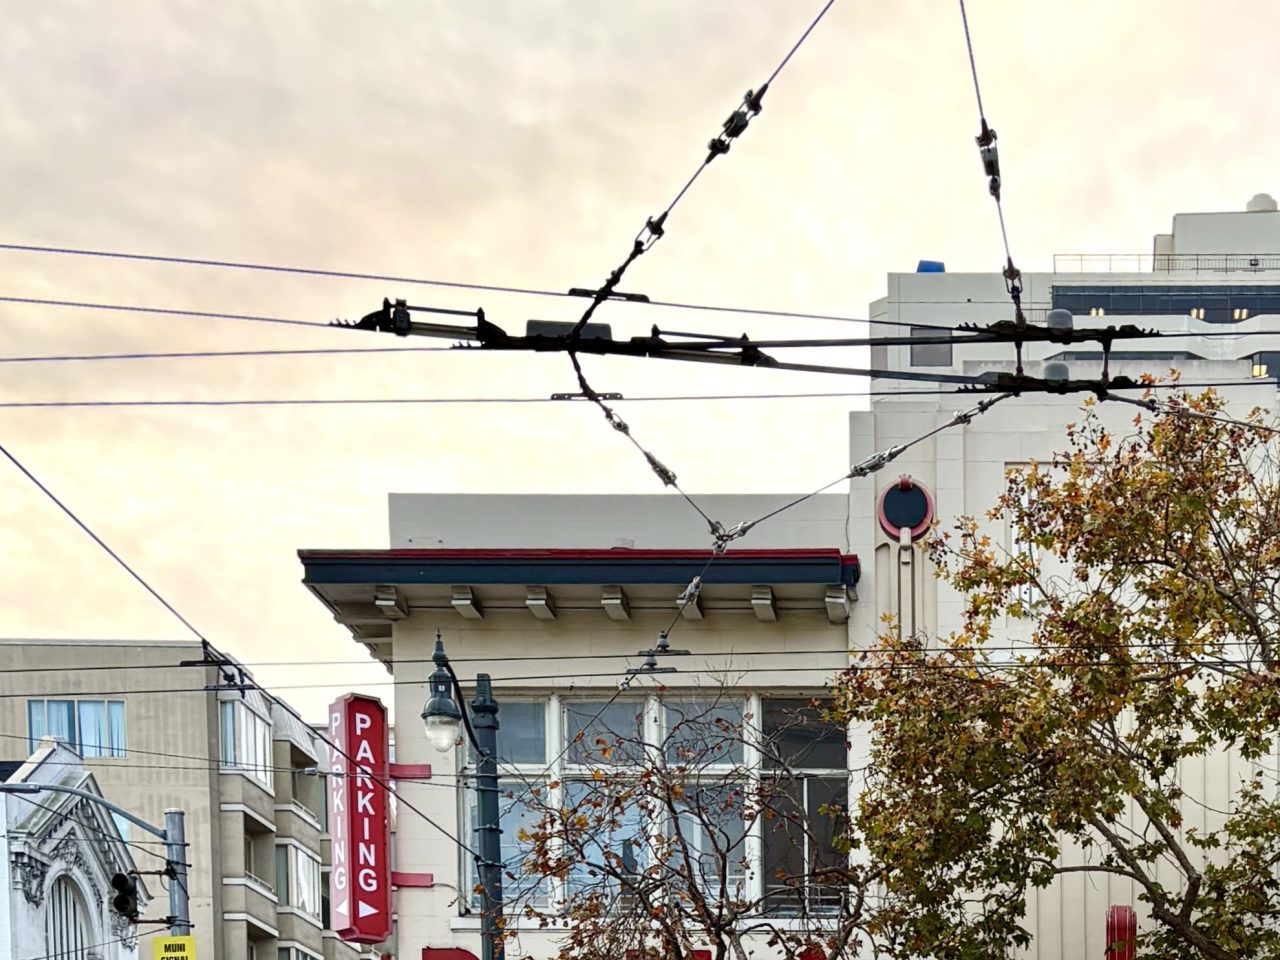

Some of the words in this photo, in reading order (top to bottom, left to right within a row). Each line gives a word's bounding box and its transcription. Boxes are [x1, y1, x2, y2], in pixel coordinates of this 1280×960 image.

[331, 711, 347, 891] PARKING
[355, 713, 378, 892] PARKING
[164, 943, 186, 953] MUNI
